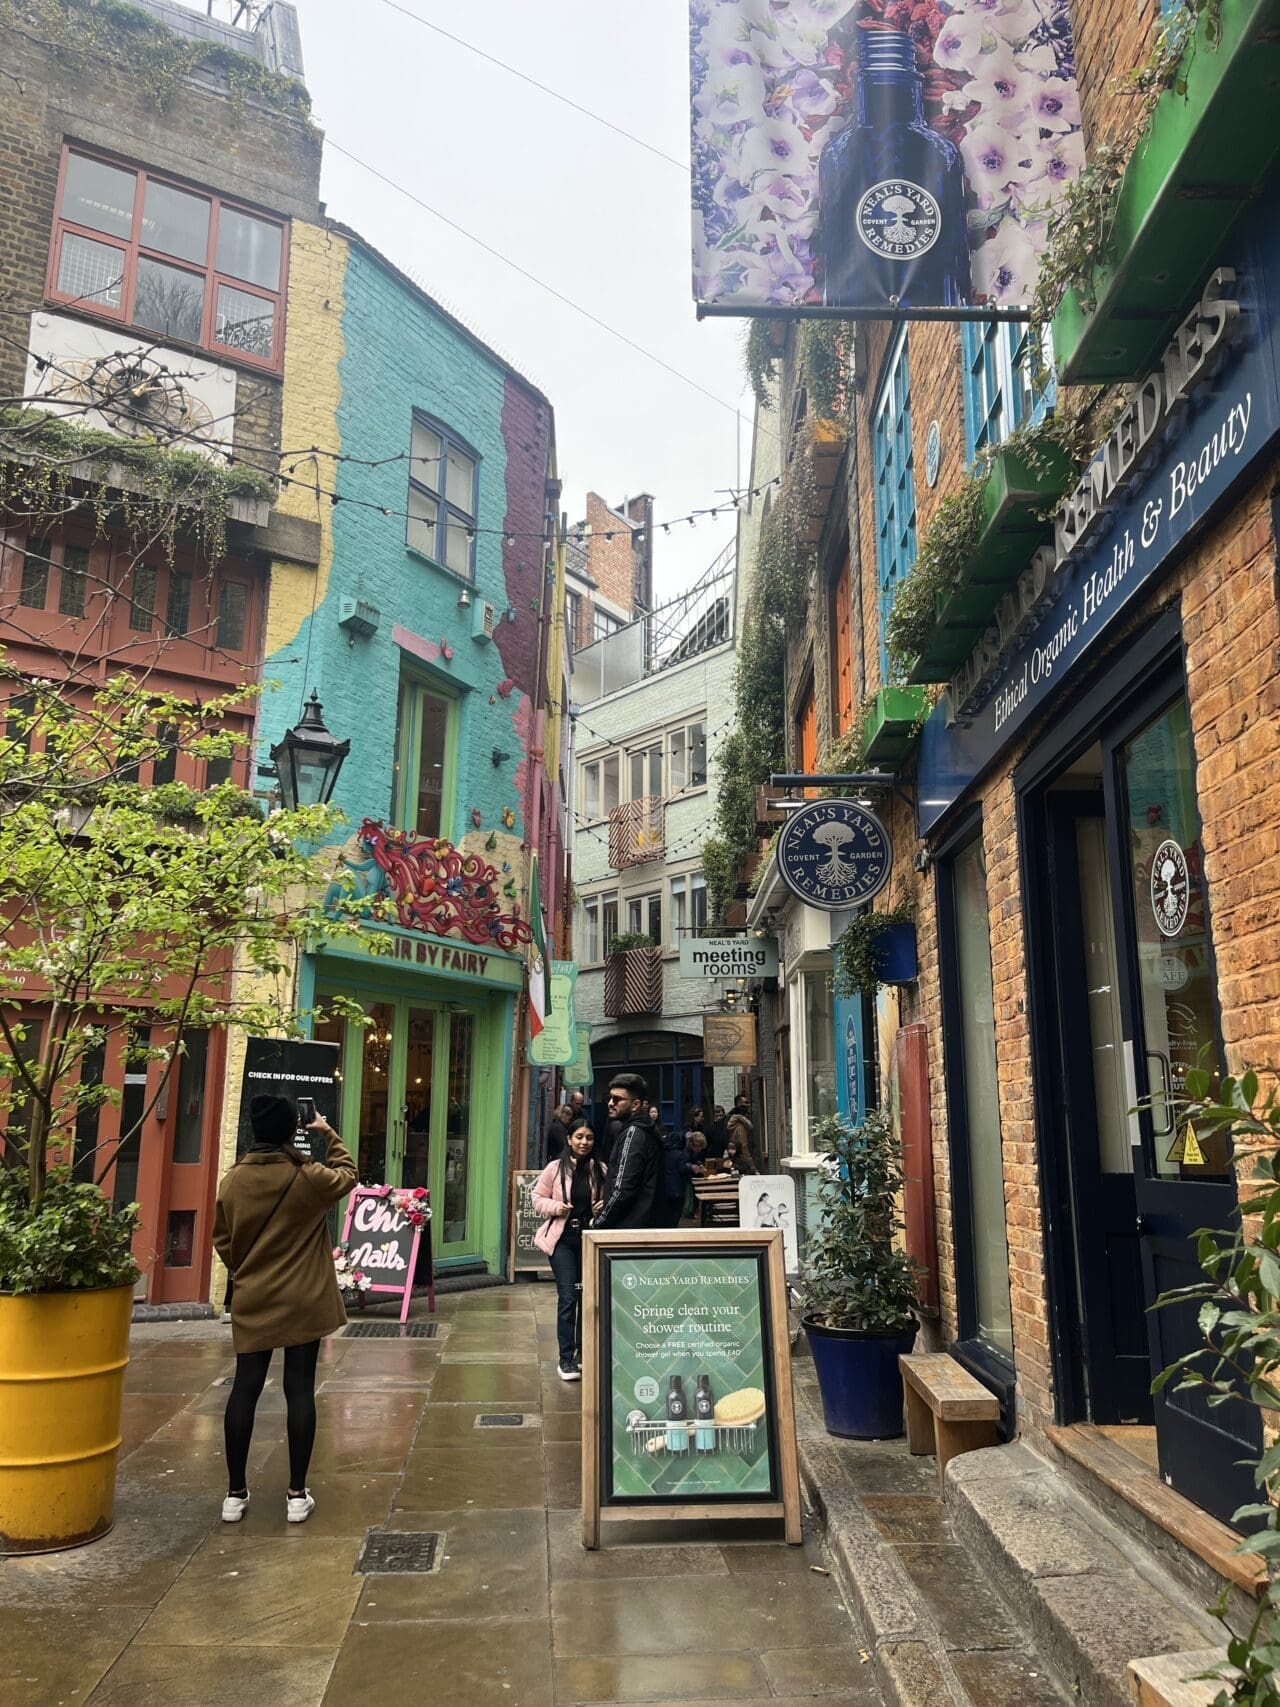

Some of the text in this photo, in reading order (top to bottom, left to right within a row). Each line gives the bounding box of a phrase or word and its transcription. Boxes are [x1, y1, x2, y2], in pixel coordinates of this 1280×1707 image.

[862, 185, 934, 216] NEAL'S YARD
[865, 227, 934, 254] REMEDIES
[1054, 266, 1240, 572] REMEDIES
[994, 392, 1252, 733] Ethical Organic Health & Beauty
[787, 807, 881, 850] NEAL'S YARD
[787, 851, 883, 862] COVENT GARDEN
[791, 863, 881, 901] REMEDIES
[416, 942, 439, 966] BY
[441, 948, 489, 976] FAIRY
[693, 948, 766, 965] meeting
[703, 963, 757, 976] rooms
[248, 1071, 333, 1084] CHECK IN FOR OUR OFFERS
[638, 1275, 750, 1286] NEAL'S YARD REMEDIES
[633, 1303, 740, 1319] Spring clean your
[643, 1320, 732, 1334] shower routine
[715, 1341, 740, 1349] organic
[635, 1350, 659, 1358] shower
[660, 1350, 671, 1359] gel
[692, 1351, 704, 1359] you
[705, 1350, 726, 1358] spend
[727, 1349, 741, 1357] £40
[639, 1388, 655, 1397] £15
